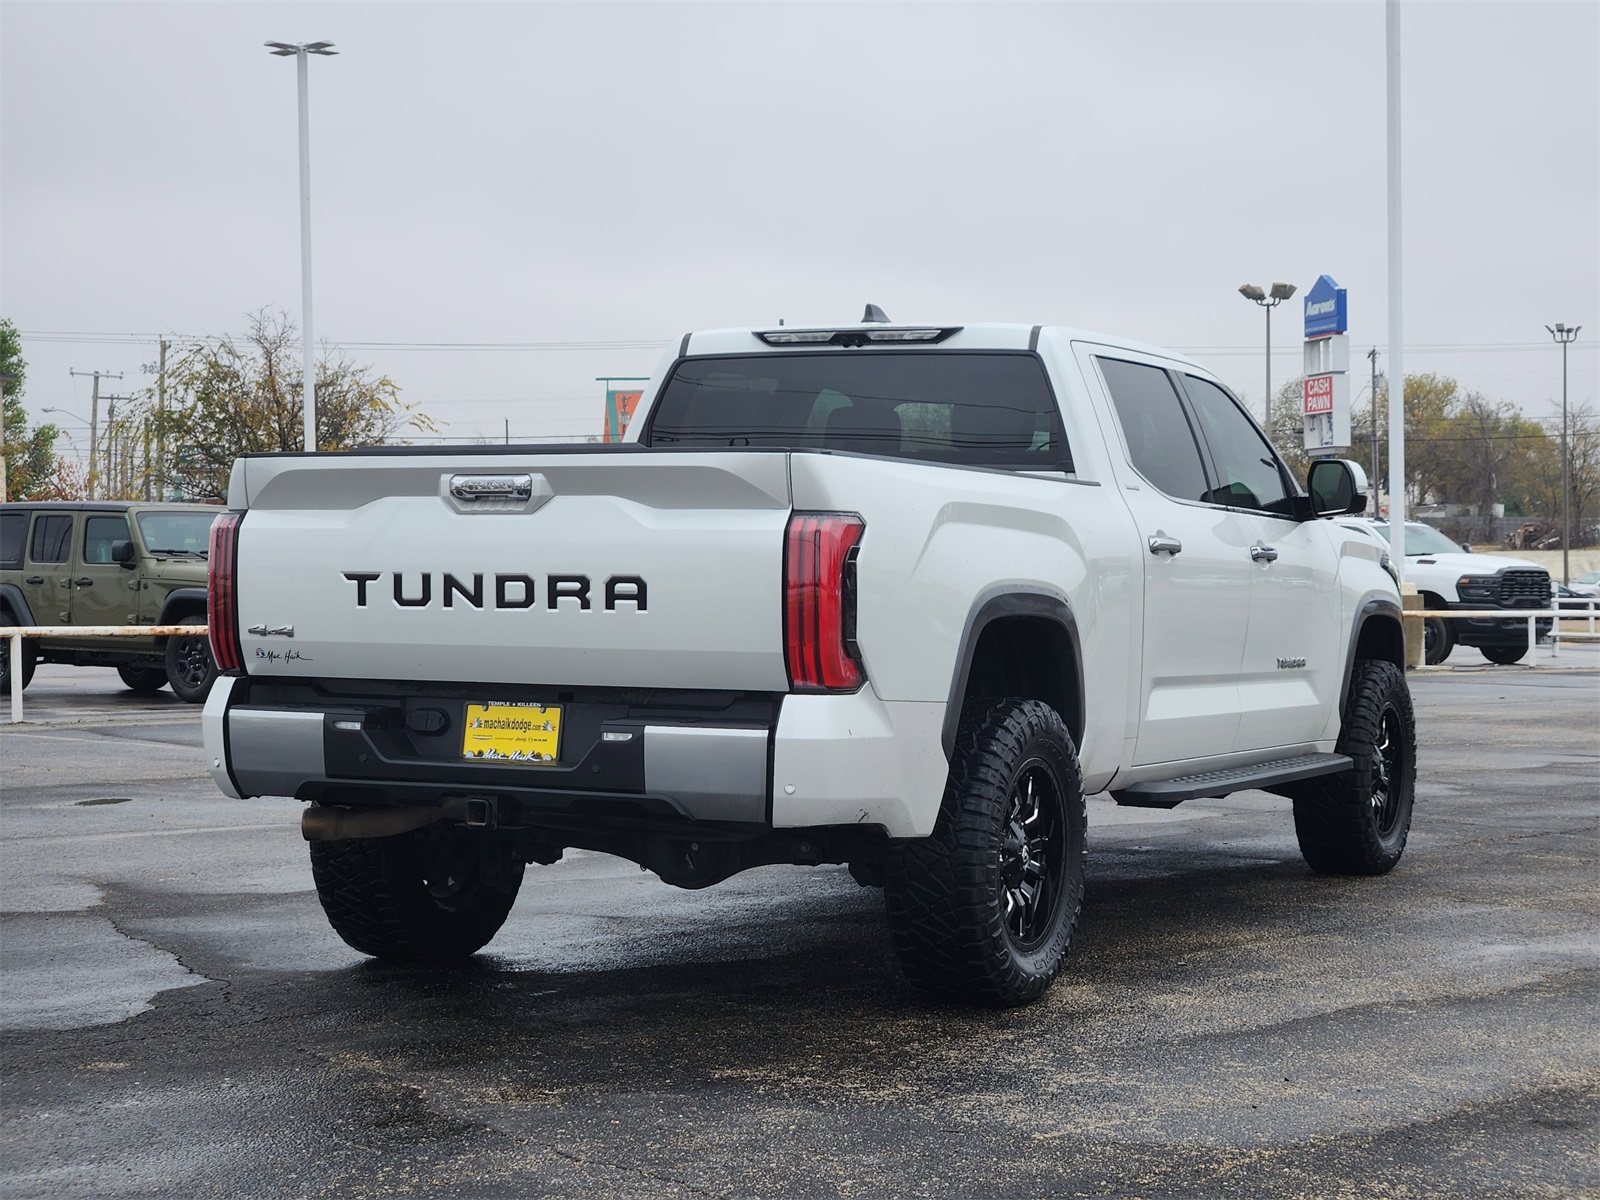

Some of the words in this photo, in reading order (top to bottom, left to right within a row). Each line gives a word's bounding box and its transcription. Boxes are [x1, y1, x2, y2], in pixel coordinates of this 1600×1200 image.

[1308, 378, 1330, 395] CASH
[1307, 395, 1331, 412] PAWN
[341, 572, 648, 613] TUNDRA
[258, 650, 283, 664] Mac
[284, 649, 314, 664] Haik
[483, 717, 542, 734] machaikdodge.com
[482, 748, 508, 760] Mac
